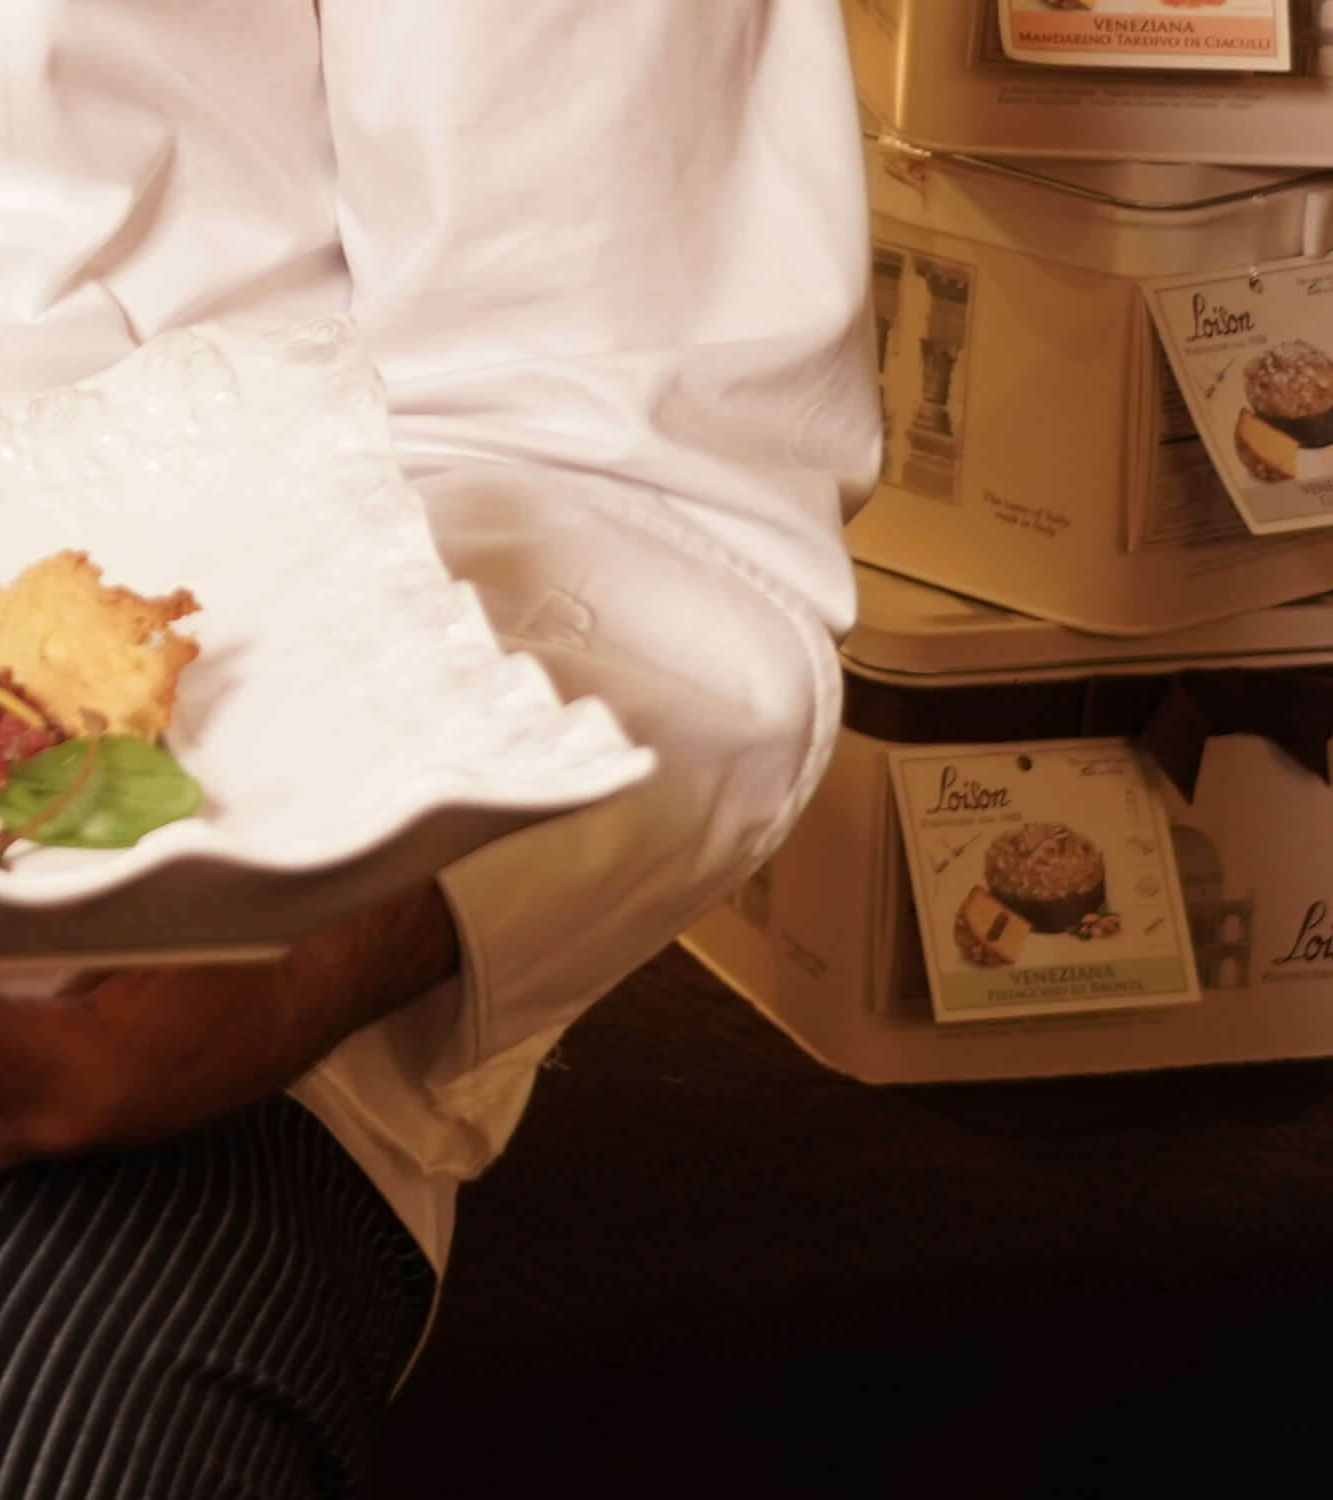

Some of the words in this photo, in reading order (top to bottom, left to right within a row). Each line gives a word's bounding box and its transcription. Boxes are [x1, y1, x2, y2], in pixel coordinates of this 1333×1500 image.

[1093, 17, 1194, 33] VENEZIANA
[1018, 31, 1111, 46] MANDARINO
[1116, 33, 1180, 47] TARDIVO
[1184, 35, 1200, 48] DI
[1186, 292, 1255, 342] Loison
[926, 765, 1012, 814] Loison
[1009, 963, 1117, 985] VENEZIANA
